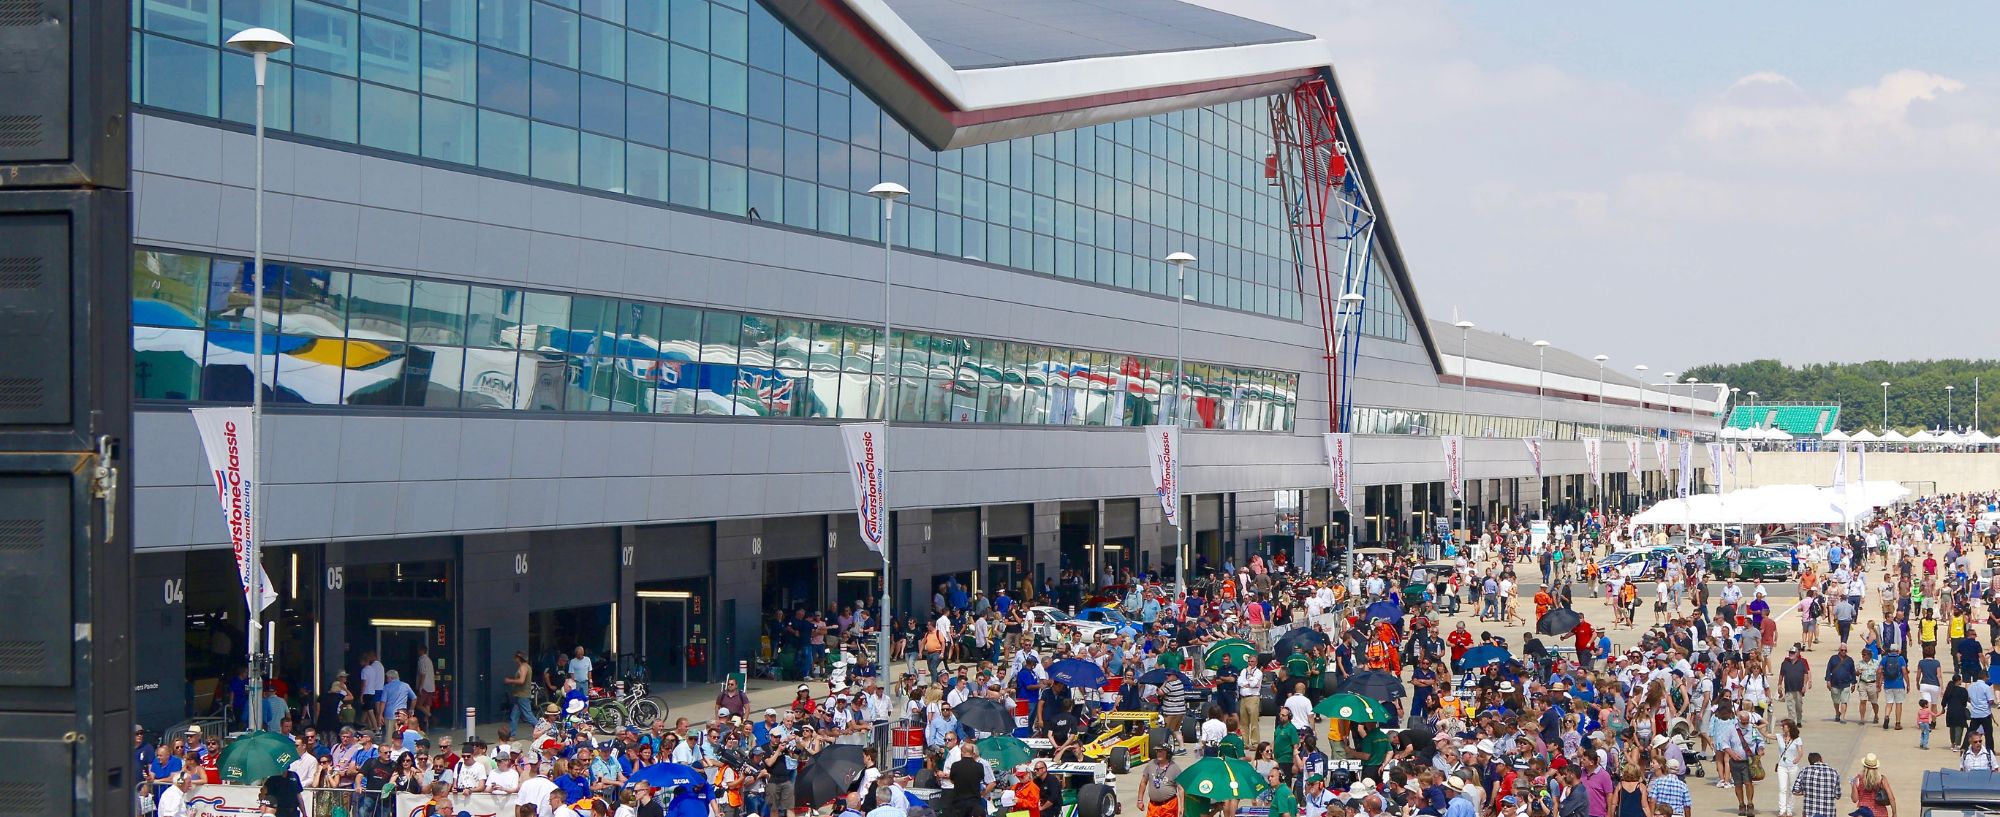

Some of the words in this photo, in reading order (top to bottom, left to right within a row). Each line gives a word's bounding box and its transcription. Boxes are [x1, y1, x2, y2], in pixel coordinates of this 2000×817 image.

[752, 537, 762, 555] 08
[828, 531, 837, 549] 09
[515, 553, 529, 575] 06
[622, 545, 634, 566] 07
[327, 566, 344, 590] 05
[164, 578, 184, 605] 04
